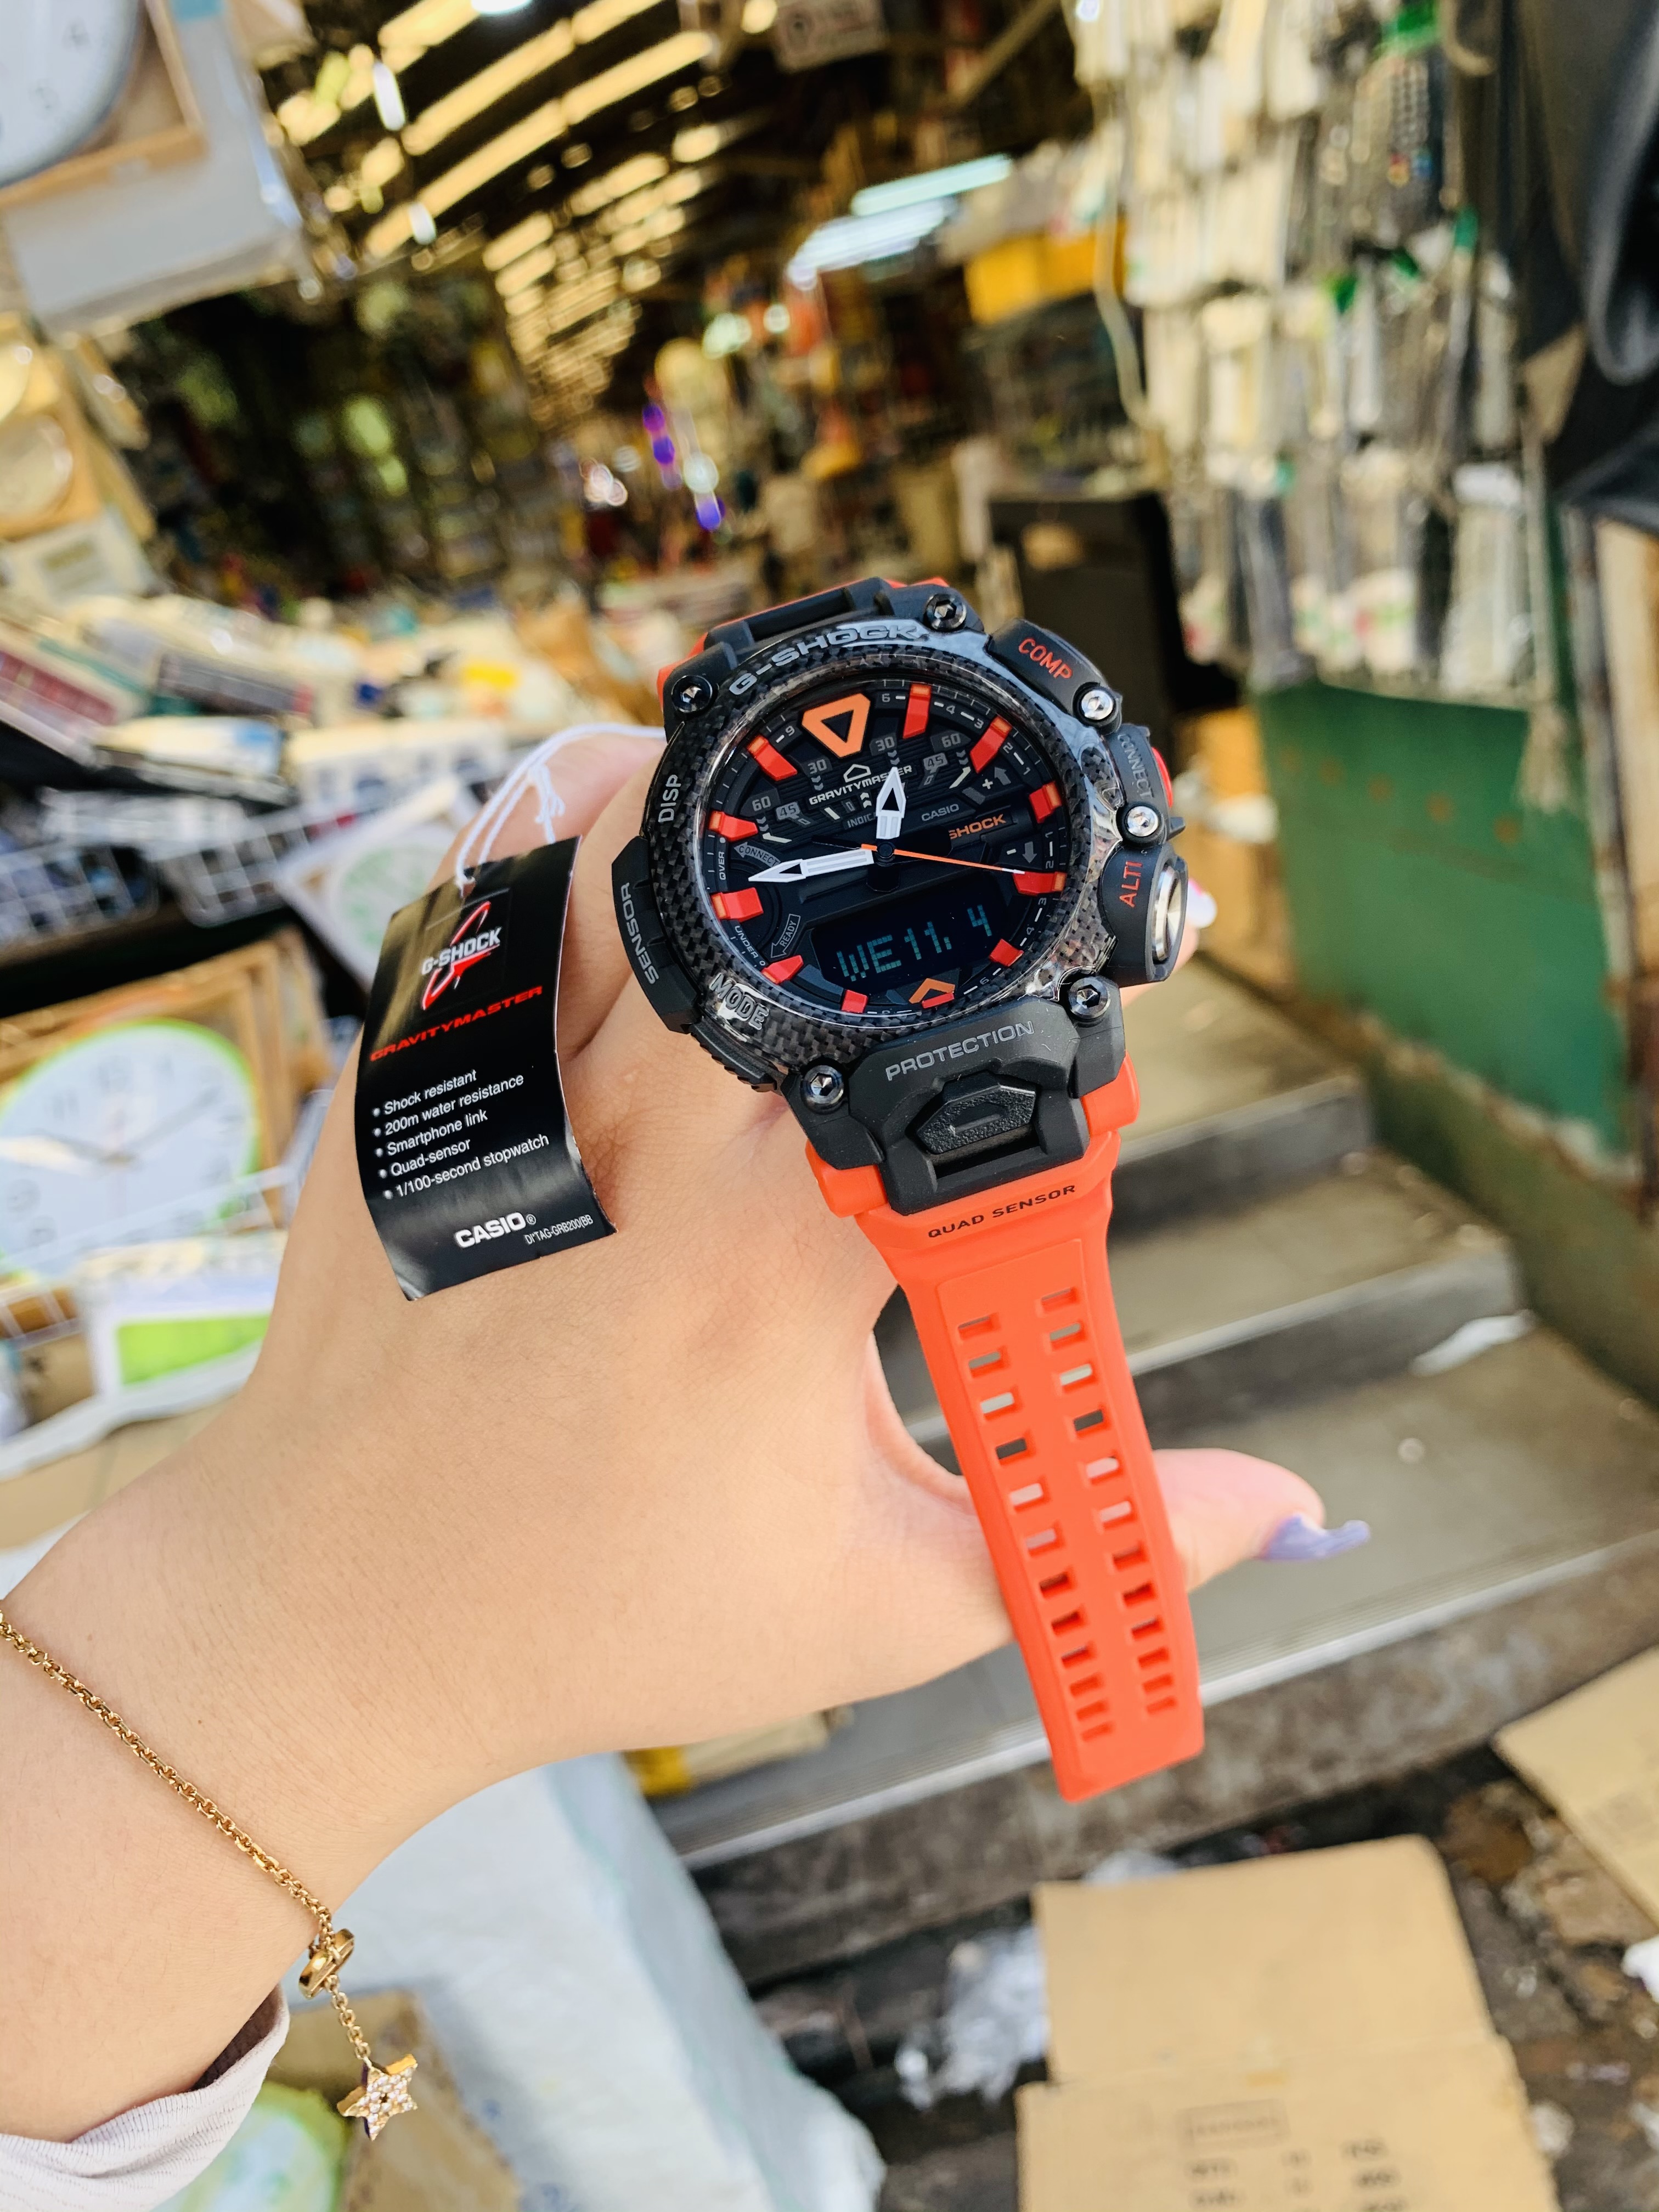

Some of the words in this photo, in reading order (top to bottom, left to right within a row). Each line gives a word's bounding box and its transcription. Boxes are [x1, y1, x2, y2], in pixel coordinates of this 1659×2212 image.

[729, 625, 921, 695] G-SHOCK
[1018, 637, 1073, 679] COMP
[946, 704, 956, 715] 4
[974, 718, 985, 729] 3
[875, 736, 895, 752] 30
[941, 732, 961, 748] 60
[808, 759, 827, 775] 30
[809, 765, 912, 805] GRAVITYMASER
[1118, 733, 1154, 799] CONNECT
[658, 774, 682, 823] DISP
[752, 795, 771, 812] 60
[780, 804, 797, 817] 45
[921, 804, 960, 821] CASIO
[847, 812, 876, 828] INDIC
[718, 851, 726, 881] OVER
[738, 845, 779, 867] CONNECT
[1119, 860, 1143, 908] ALTI
[620, 882, 659, 985] SENSOR
[778, 920, 797, 948] READY
[967, 904, 992, 936] 4
[421, 927, 503, 976] G-SHOCK
[735, 925, 759, 959] UNDER
[708, 973, 770, 1030] MODE
[369, 985, 543, 1062] GRAVITYMASTER
[885, 1020, 1035, 1081] PROTECTION
[384, 1092, 421, 1115] Shock
[424, 1069, 477, 1100] resistant
[385, 1113, 419, 1136] 200m
[422, 1099, 456, 1121] water
[459, 1074, 524, 1108] resistance
[386, 1118, 462, 1156] Smartphone
[465, 1108, 488, 1127] link
[390, 1138, 471, 1177] Quad-sensor
[396, 1159, 481, 1198] 1/100-second
[483, 1133, 549, 1167] stopwatch
[928, 1214, 985, 1238] QUAD
[992, 1184, 1077, 1218] SENSOR
